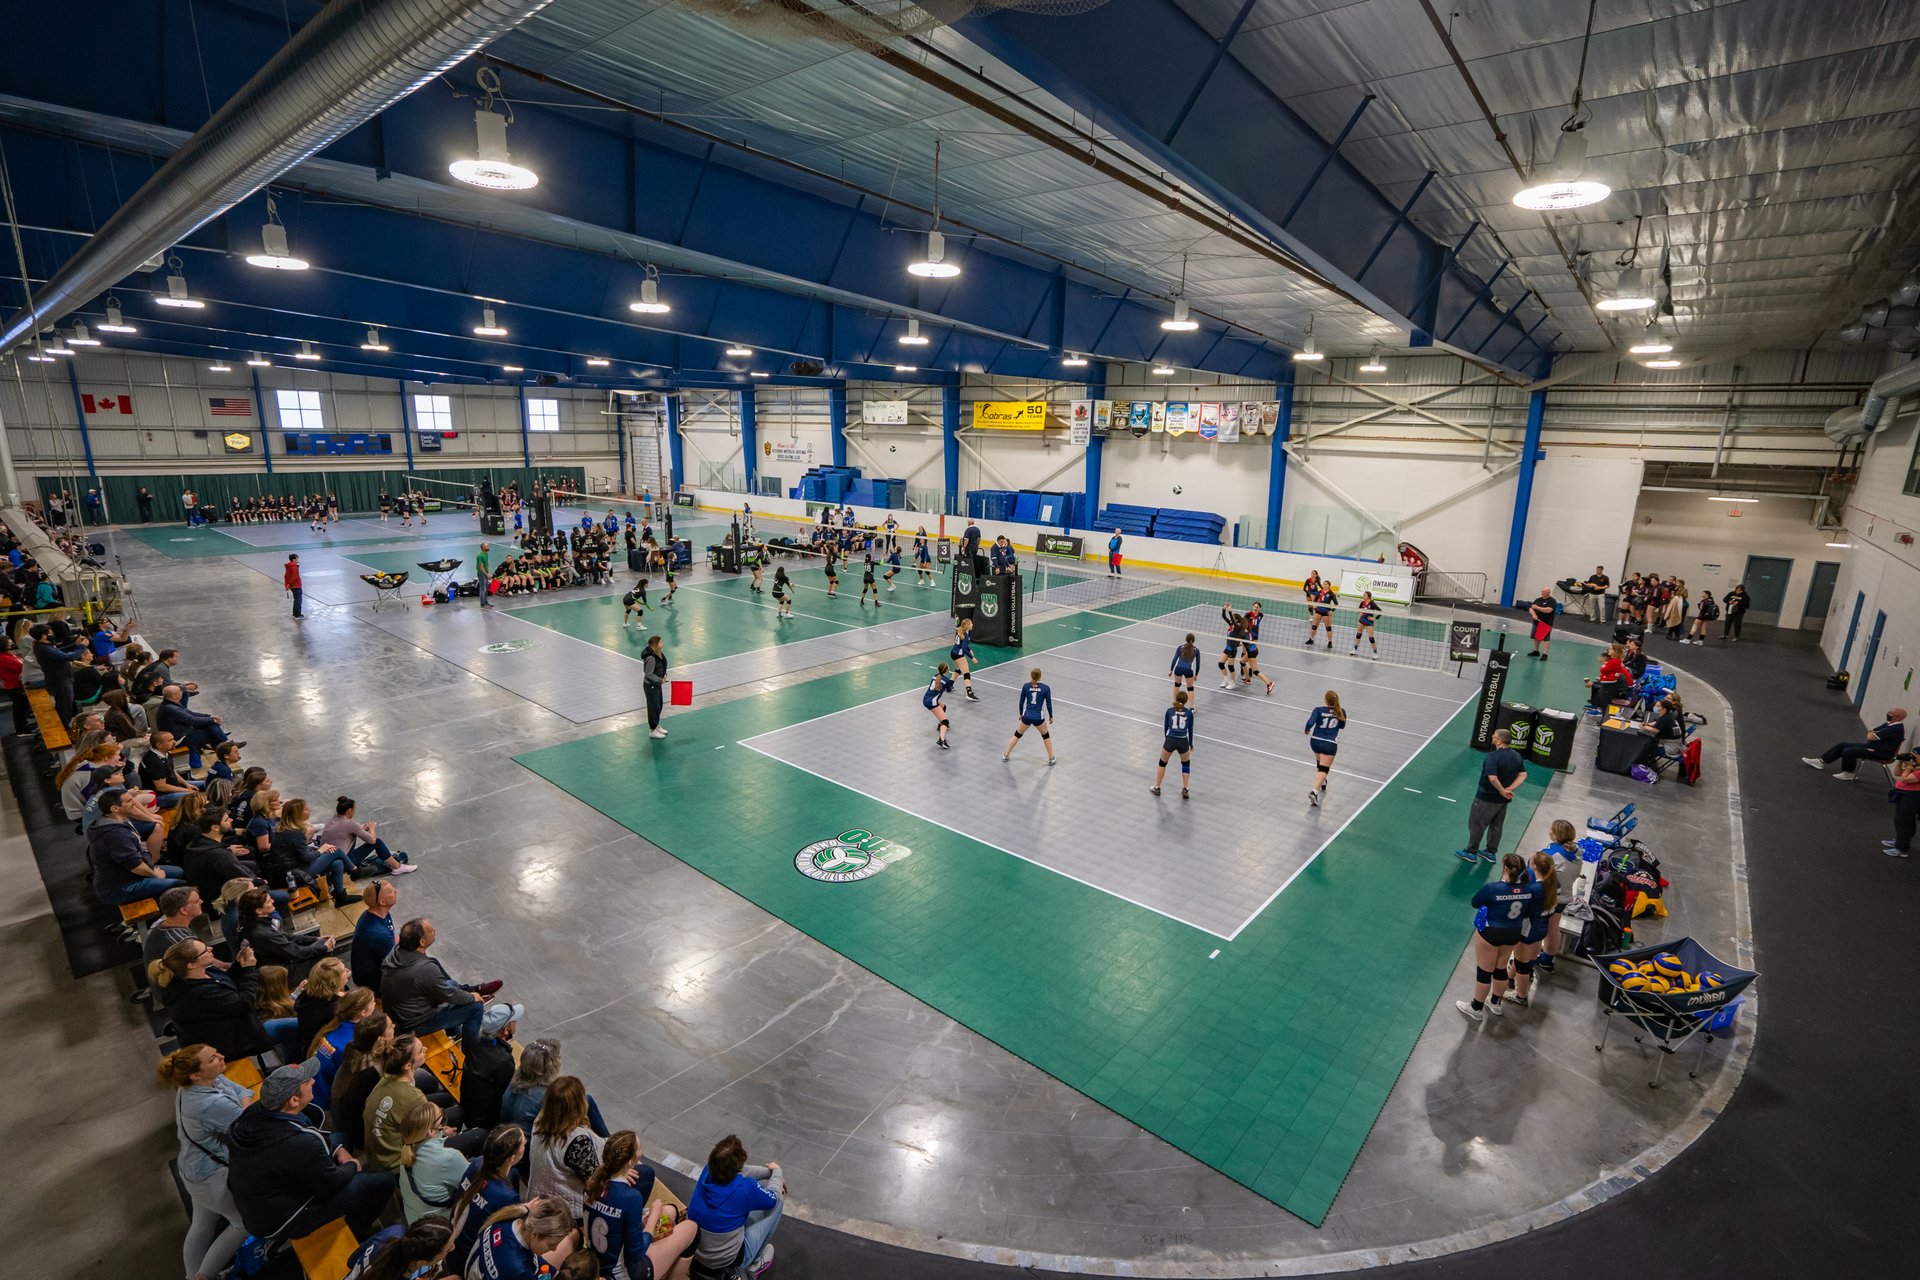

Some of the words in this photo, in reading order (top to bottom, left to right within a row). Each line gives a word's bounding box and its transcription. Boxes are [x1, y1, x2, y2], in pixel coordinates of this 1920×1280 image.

[1027, 405, 1043, 414] 50
[941, 545, 948, 555] 3
[1372, 580, 1398, 588] ONTARIO
[1453, 625, 1480, 634] COURT
[1460, 634, 1472, 648] 4
[1031, 691, 1037, 704] 1
[1478, 713, 1491, 742] ONTARIO
[1485, 672, 1501, 713] VOLLEYBALL
[1532, 741, 1551, 753] ONTARIO
[803, 860, 884, 882] VOLLEYBALL
[1507, 900, 1523, 919] 8
[1687, 991, 1726, 1007] molten
